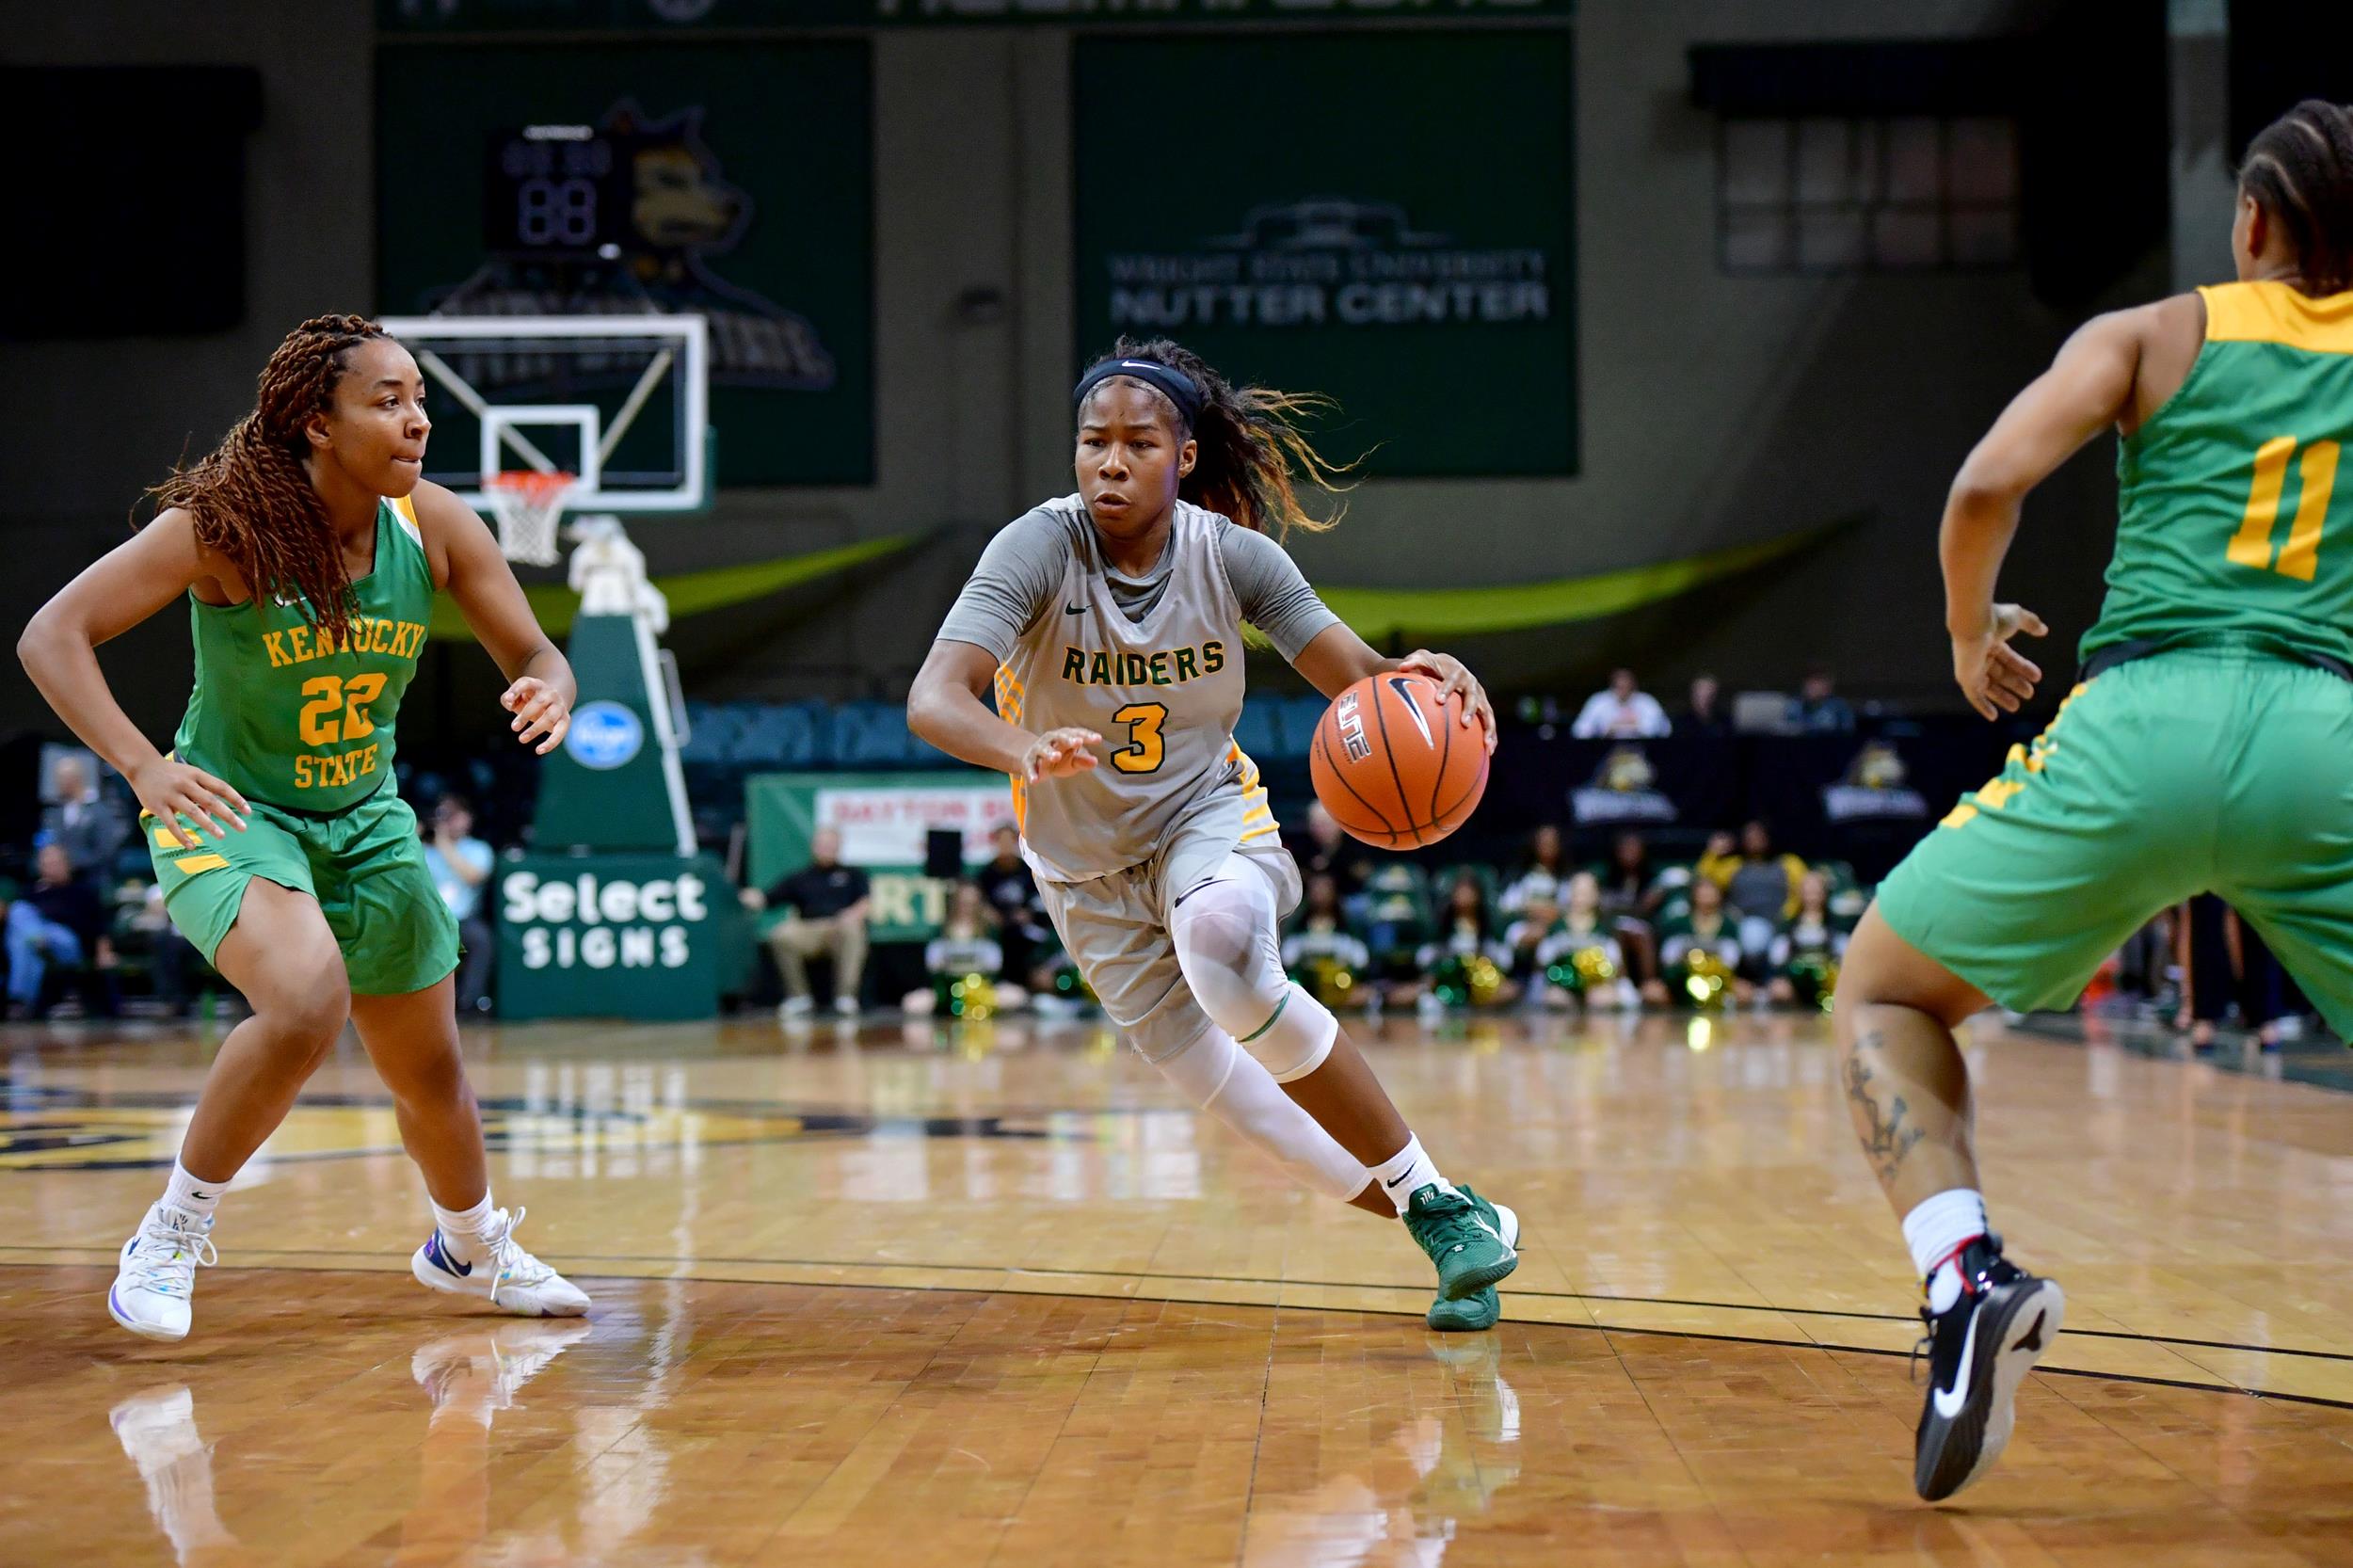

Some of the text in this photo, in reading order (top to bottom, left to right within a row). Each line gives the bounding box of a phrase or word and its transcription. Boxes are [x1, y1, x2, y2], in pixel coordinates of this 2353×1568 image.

[1109, 282, 1549, 326] NUTTER CENTER
[2226, 436, 2341, 583] 11
[1061, 640, 1225, 686] RAIDERS
[299, 672, 388, 746] 22
[1337, 690, 1372, 763] ELITE
[1111, 701, 1169, 775] 3
[295, 743, 378, 789] STATE
[503, 871, 707, 926] Select
[521, 925, 690, 969] SIGNS
